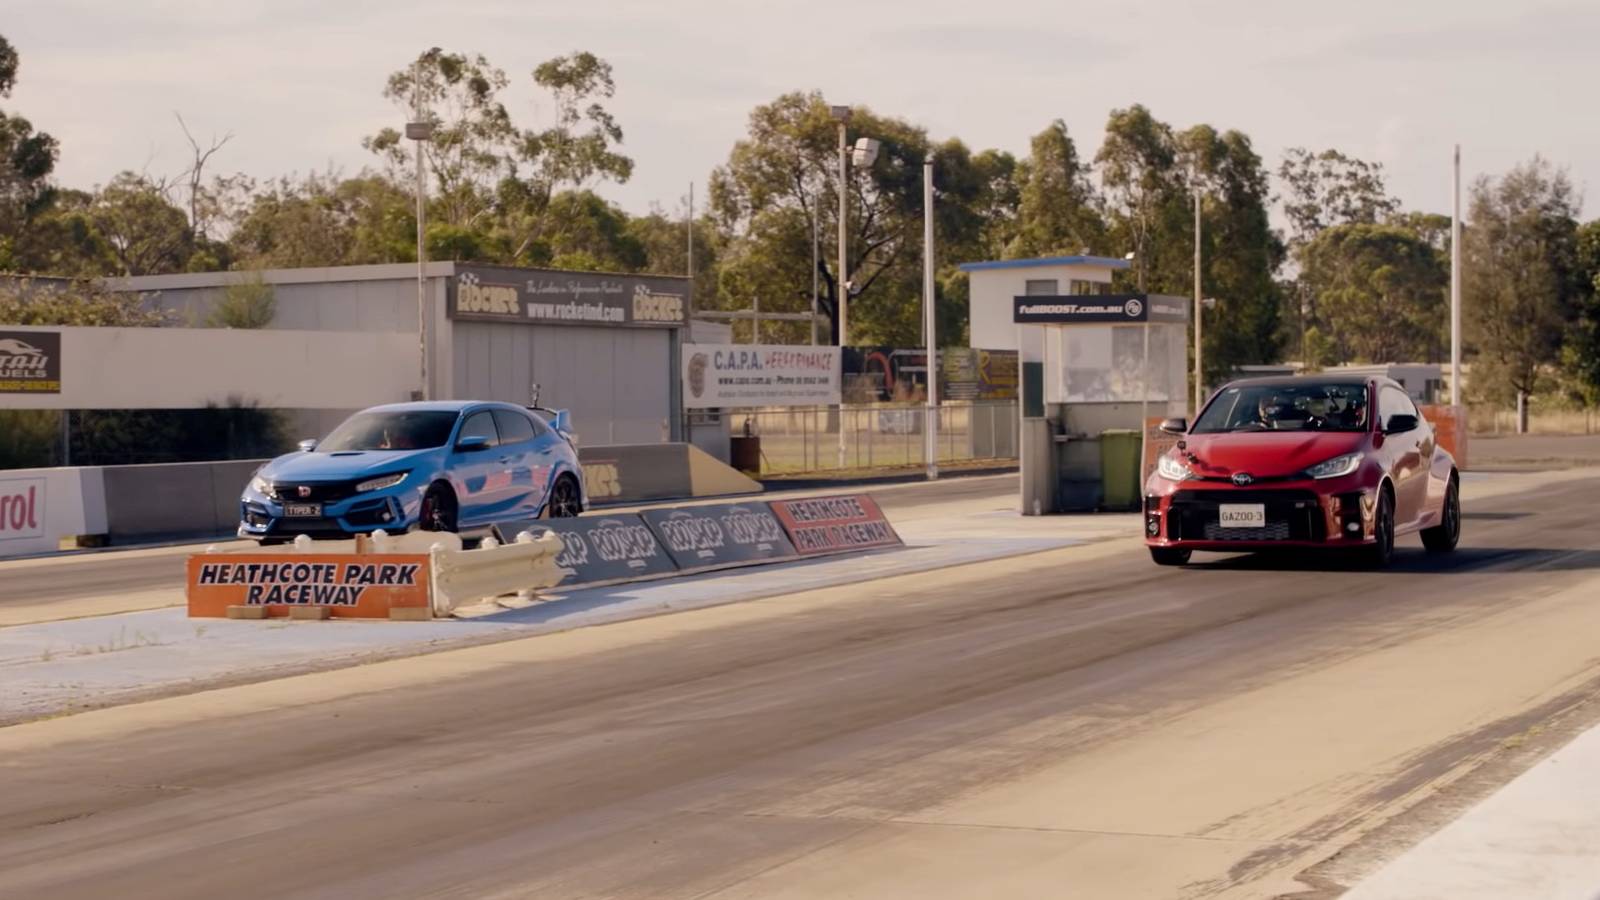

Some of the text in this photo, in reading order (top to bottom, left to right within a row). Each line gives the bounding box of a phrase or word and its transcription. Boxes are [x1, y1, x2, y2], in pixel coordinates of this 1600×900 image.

[527, 301, 625, 322] www.rocketind.com
[714, 350, 763, 371] C.A.P.A.
[785, 498, 865, 522] HEATHCOTE
[794, 522, 890, 549] PARK RACEWAY
[200, 562, 420, 585] HEATHCOTE PARK
[247, 585, 367, 608] RACEWAY
